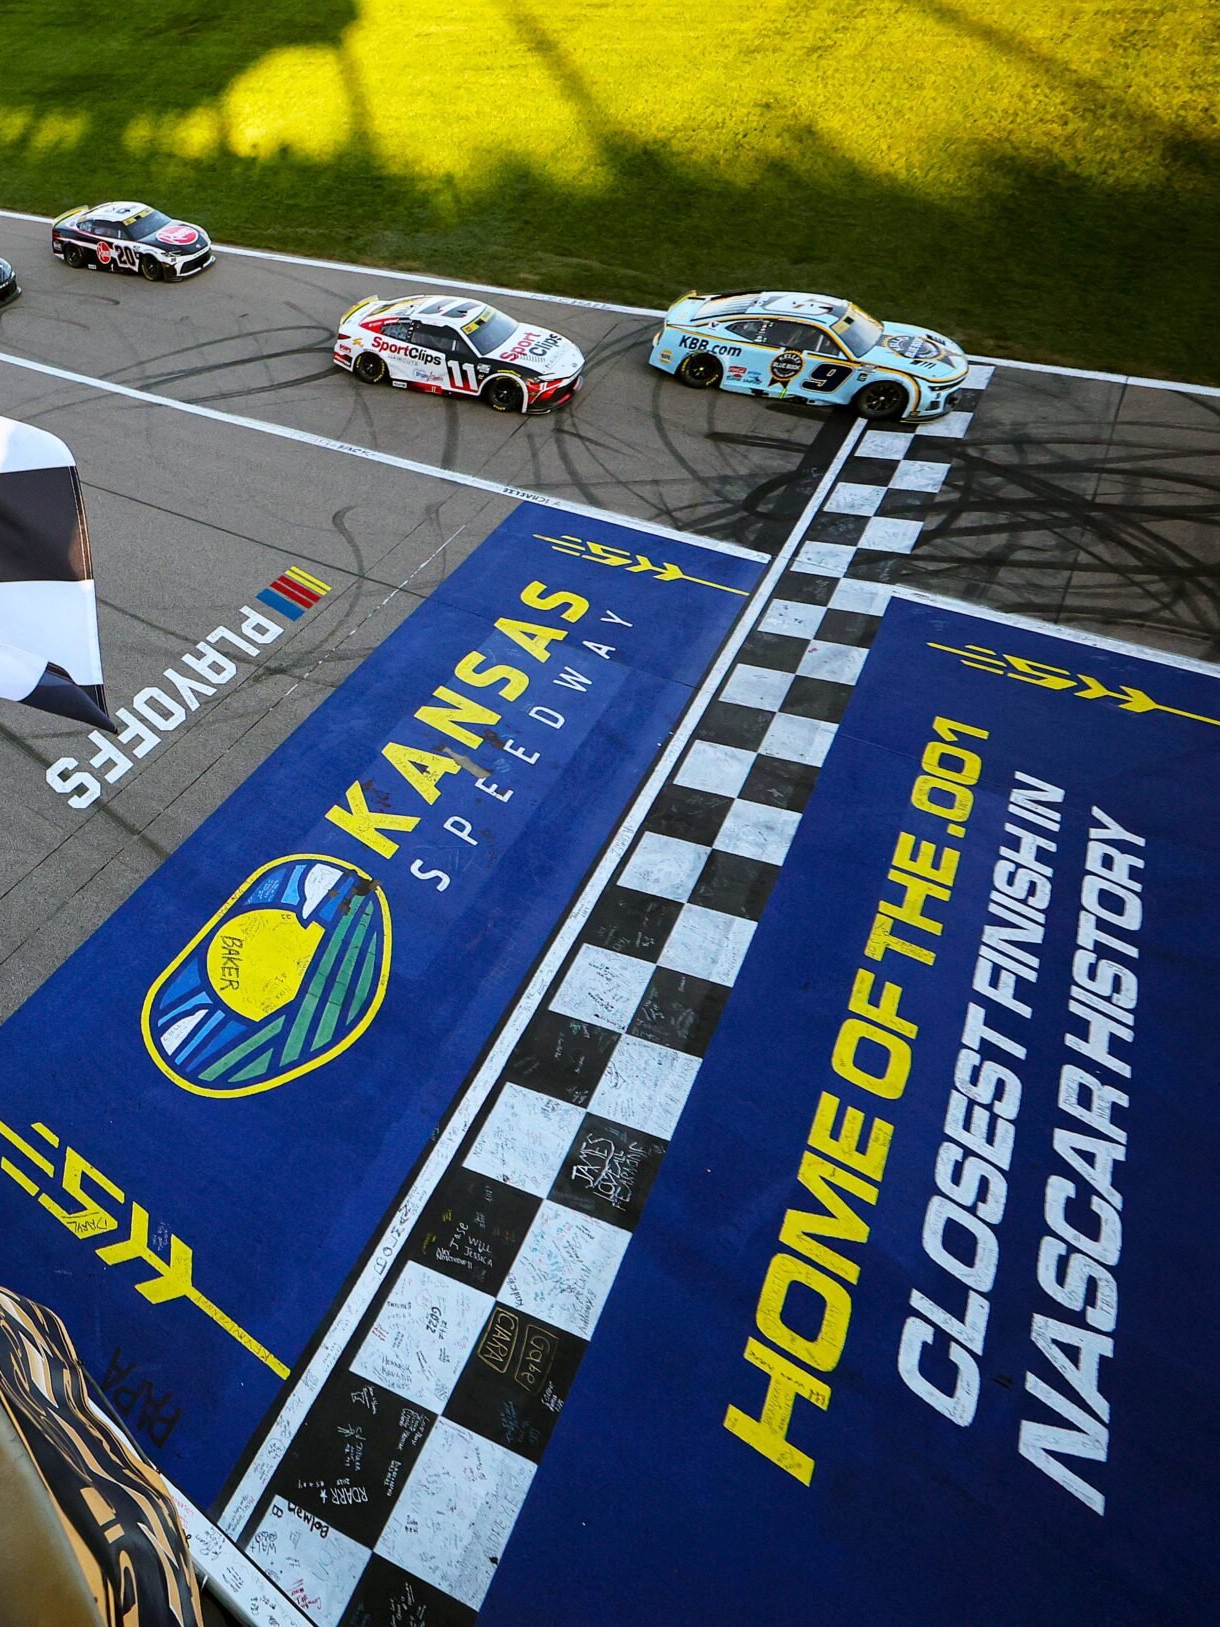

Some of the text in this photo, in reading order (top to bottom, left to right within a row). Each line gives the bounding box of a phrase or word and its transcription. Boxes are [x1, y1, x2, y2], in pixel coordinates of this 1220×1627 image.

[114, 244, 136, 267] 20
[499, 331, 541, 362] Sport
[529, 333, 562, 357] Clips
[679, 335, 742, 357] KBB.com
[447, 360, 478, 391] 11
[803, 363, 853, 392] 9
[46, 605, 284, 809] PLAYOFFS
[325, 580, 589, 859] KANSAS
[410, 610, 633, 892] SPEEDWAY
[220, 935, 244, 991] BAKER
[723, 716, 989, 1487] HOME OF THE .001
[897, 771, 1065, 1427] CLOSEST FINISH IN
[1018, 806, 1146, 1516] NASCAR HISTORY
[484, 1313, 515, 1365] CIARA
[521, 1335, 550, 1384] Gabe
